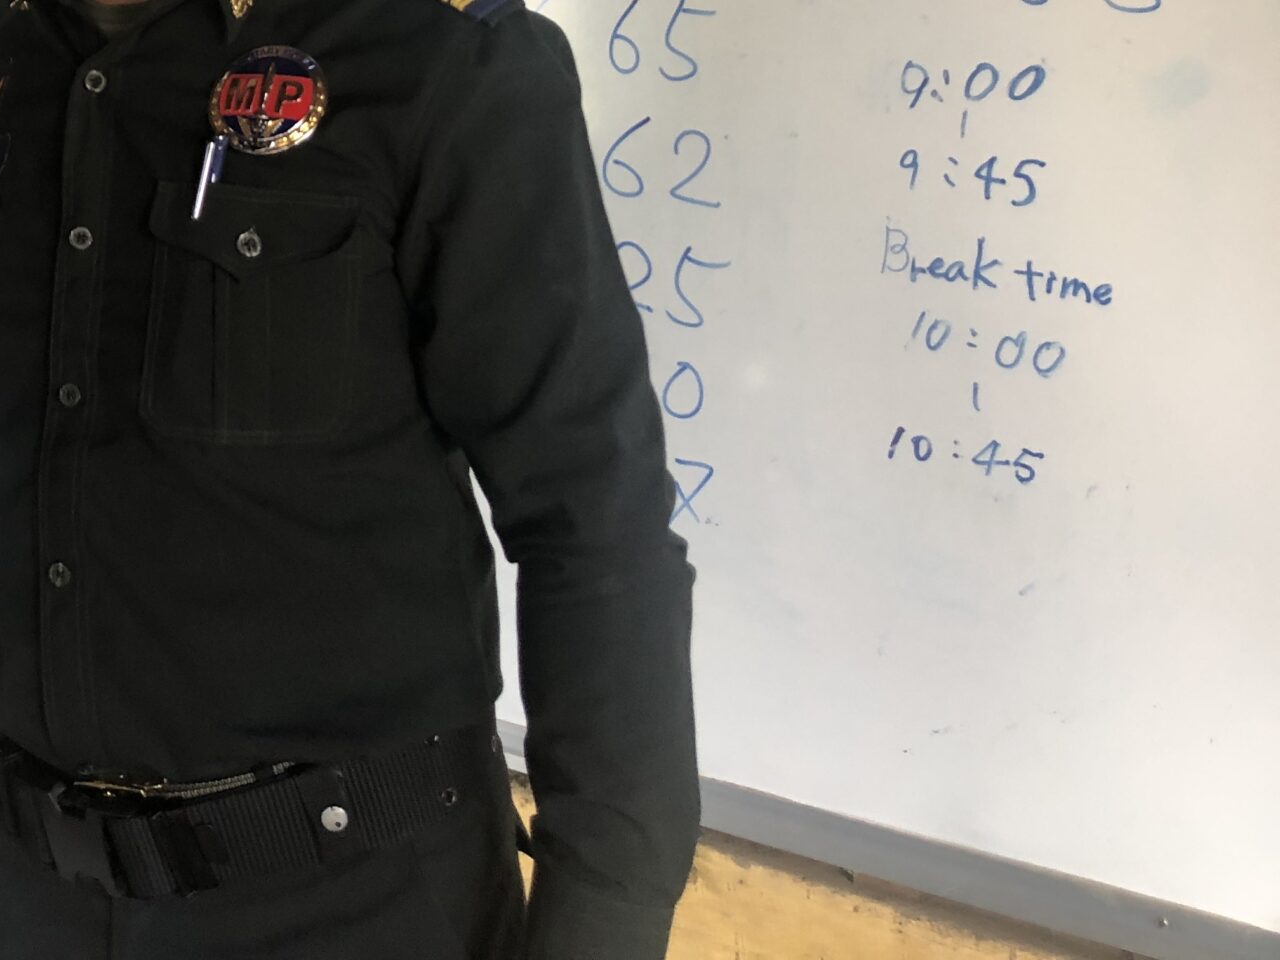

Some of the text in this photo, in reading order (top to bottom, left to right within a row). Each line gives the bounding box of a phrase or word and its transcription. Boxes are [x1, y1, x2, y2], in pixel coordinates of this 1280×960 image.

[602, 115, 722, 209] 62
[880, 224, 1114, 306] Break time
